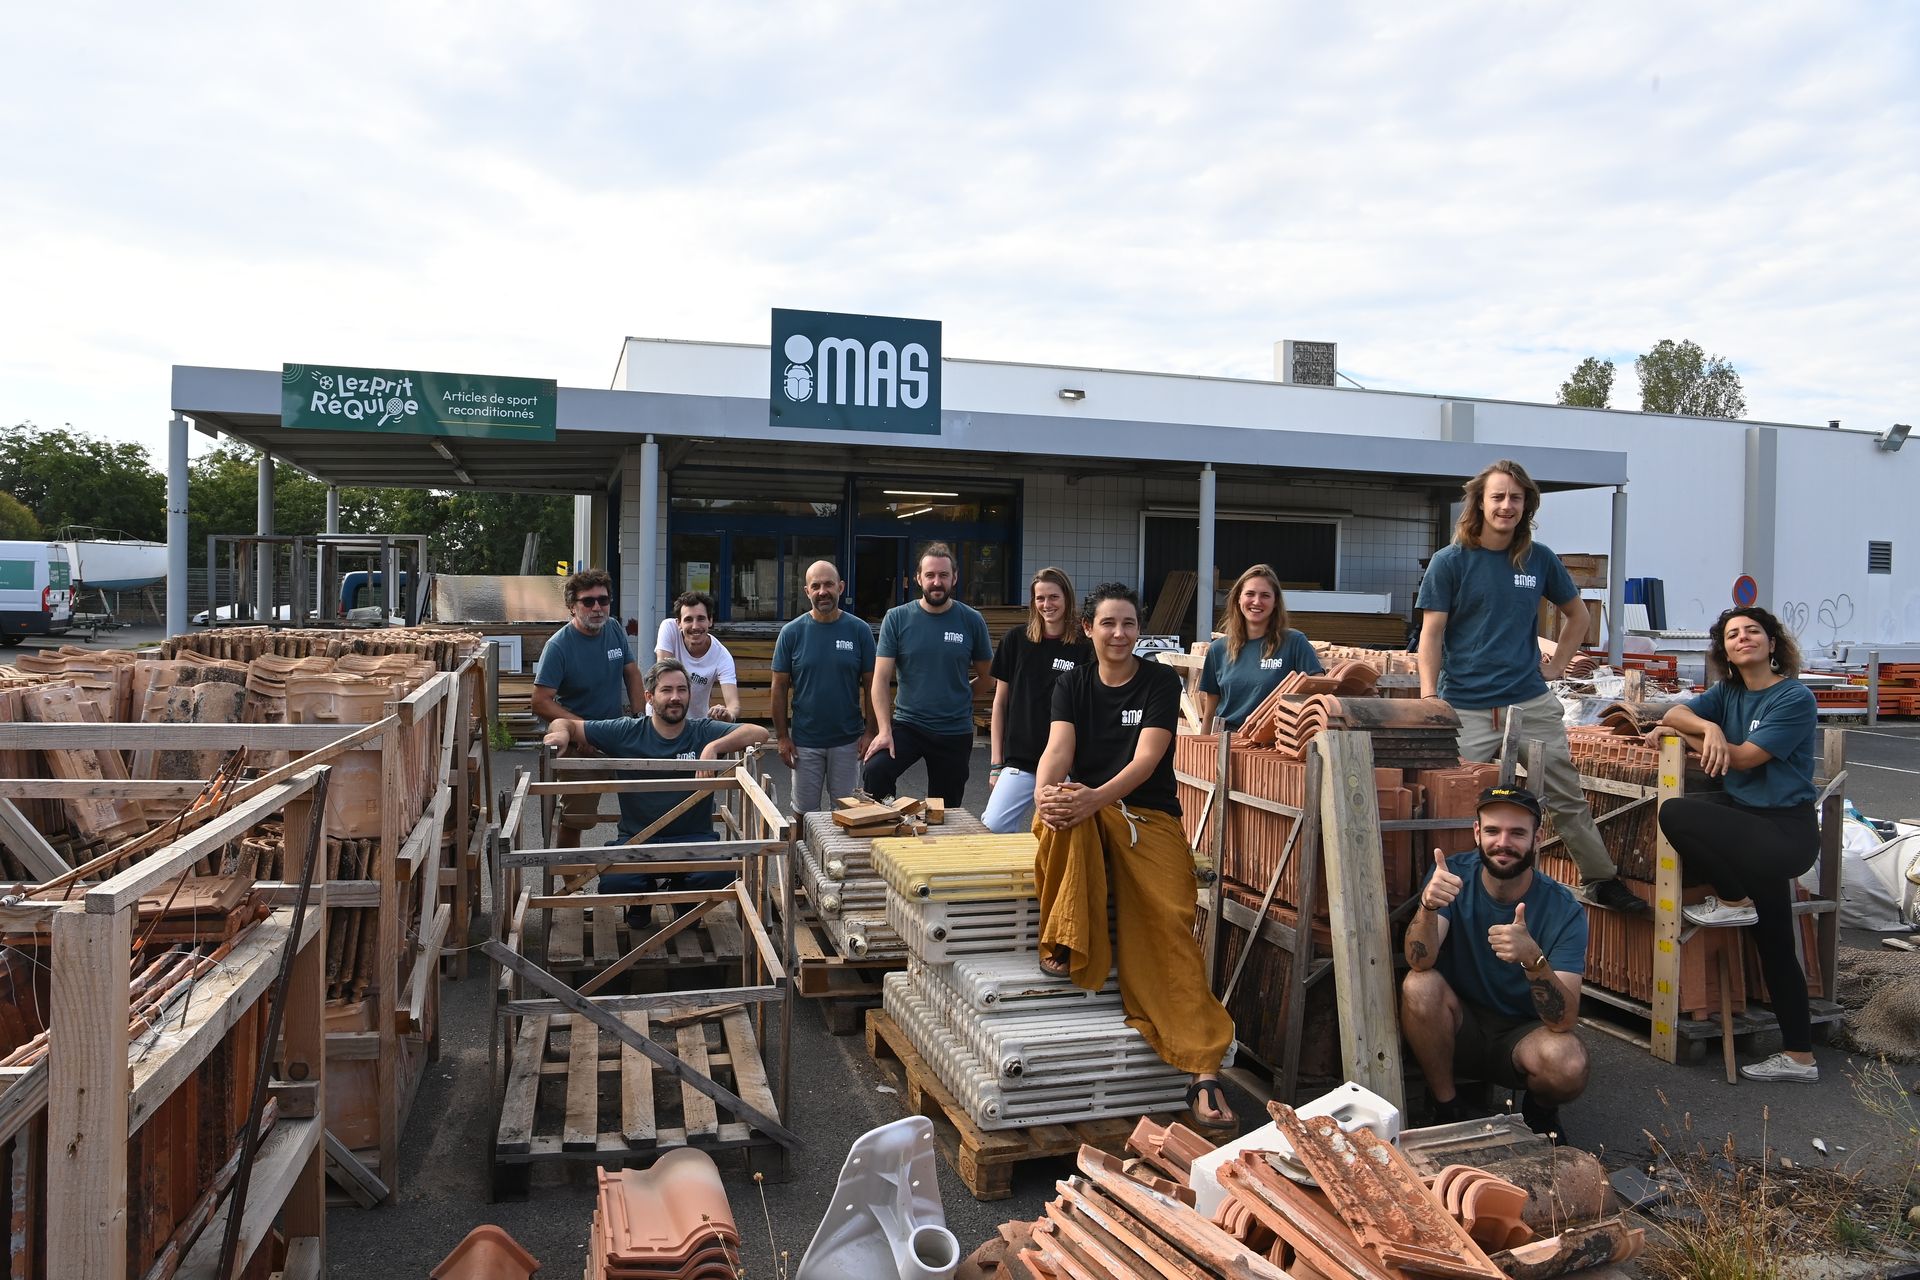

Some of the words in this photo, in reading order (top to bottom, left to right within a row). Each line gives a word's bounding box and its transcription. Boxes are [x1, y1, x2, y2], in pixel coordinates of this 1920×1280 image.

[442, 390, 487, 402] Articles
[489, 393, 504, 404] de
[507, 396, 538, 407] sport
[448, 406, 534, 419] reconditionnés
